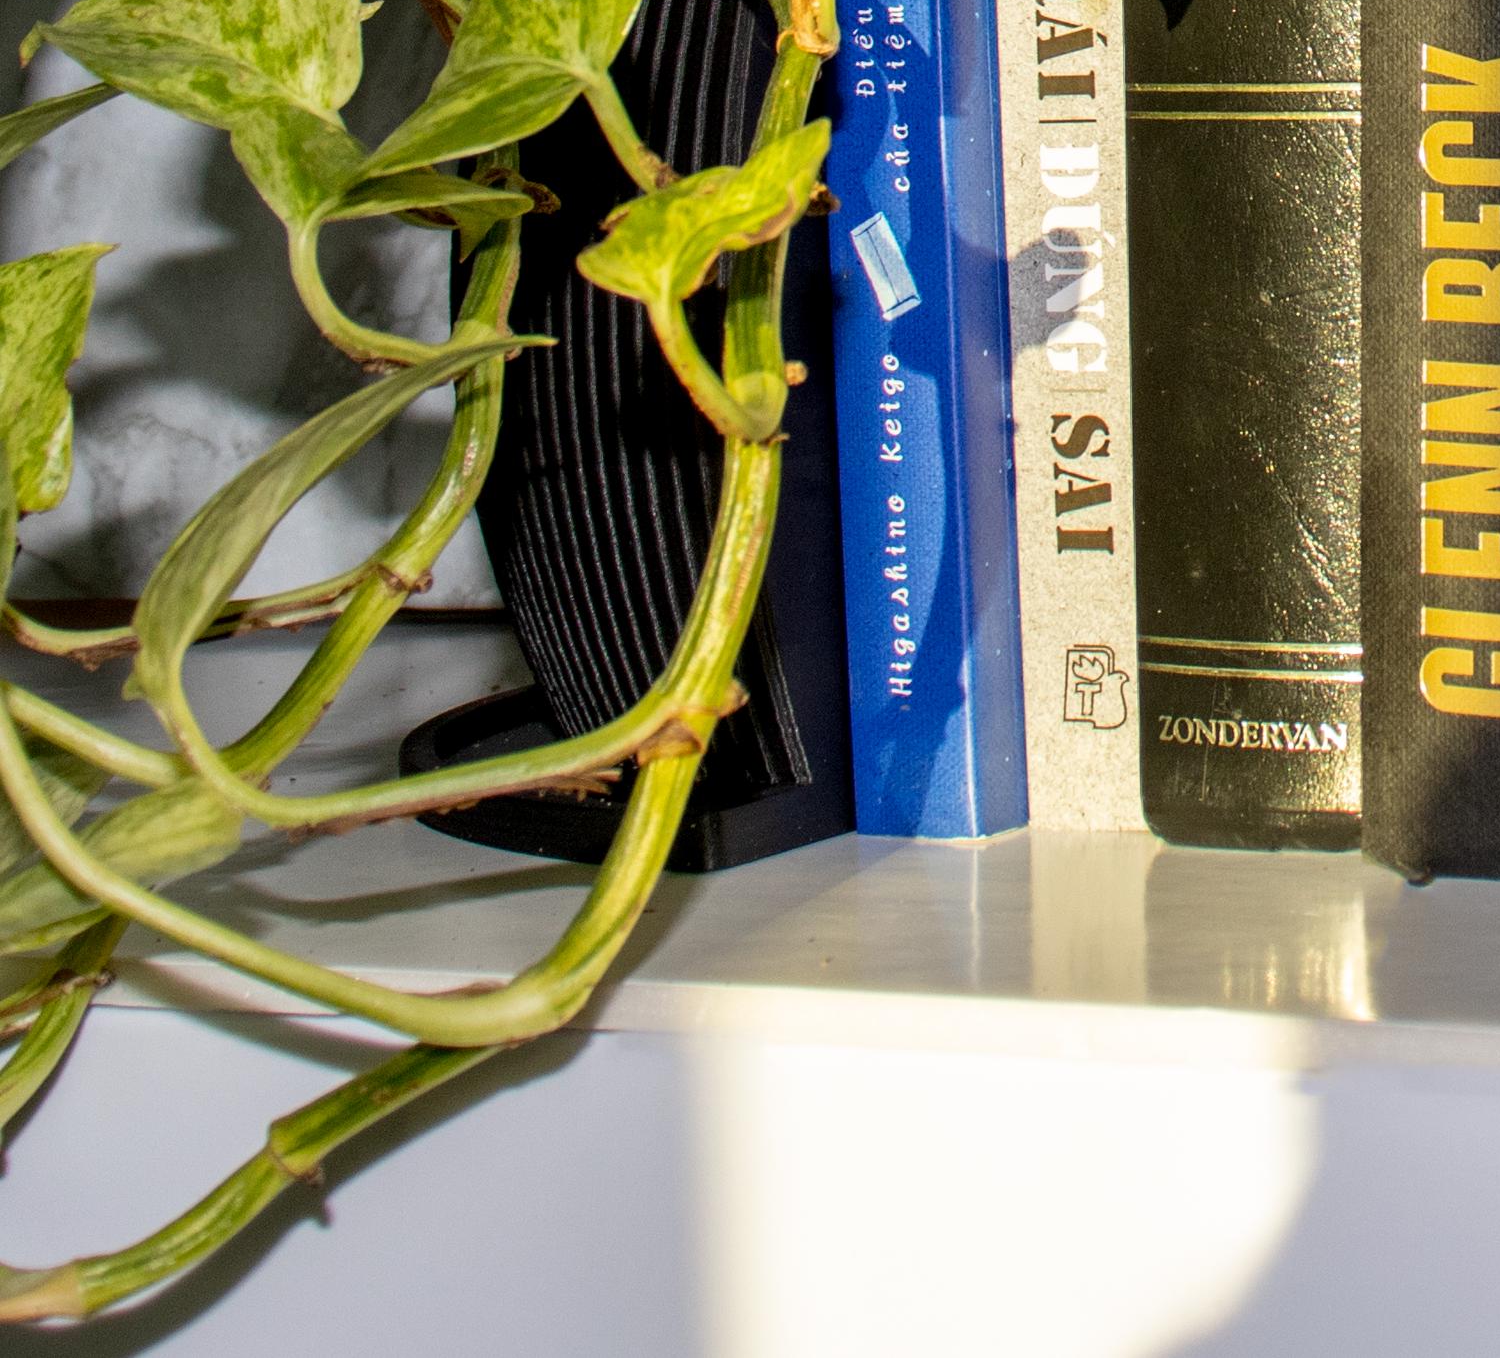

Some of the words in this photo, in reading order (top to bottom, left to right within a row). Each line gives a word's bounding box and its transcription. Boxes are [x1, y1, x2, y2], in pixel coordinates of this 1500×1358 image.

[852, 8, 877, 98] Điều
[884, 4, 912, 92] tiệm
[884, 123, 911, 194] của
[1040, 142, 1112, 377] ĐÚNG
[878, 353, 905, 464] Keigo
[1049, 412, 1114, 556] SAI
[883, 495, 917, 698] Higashino
[1158, 715, 1347, 752] ZONDERVAN
